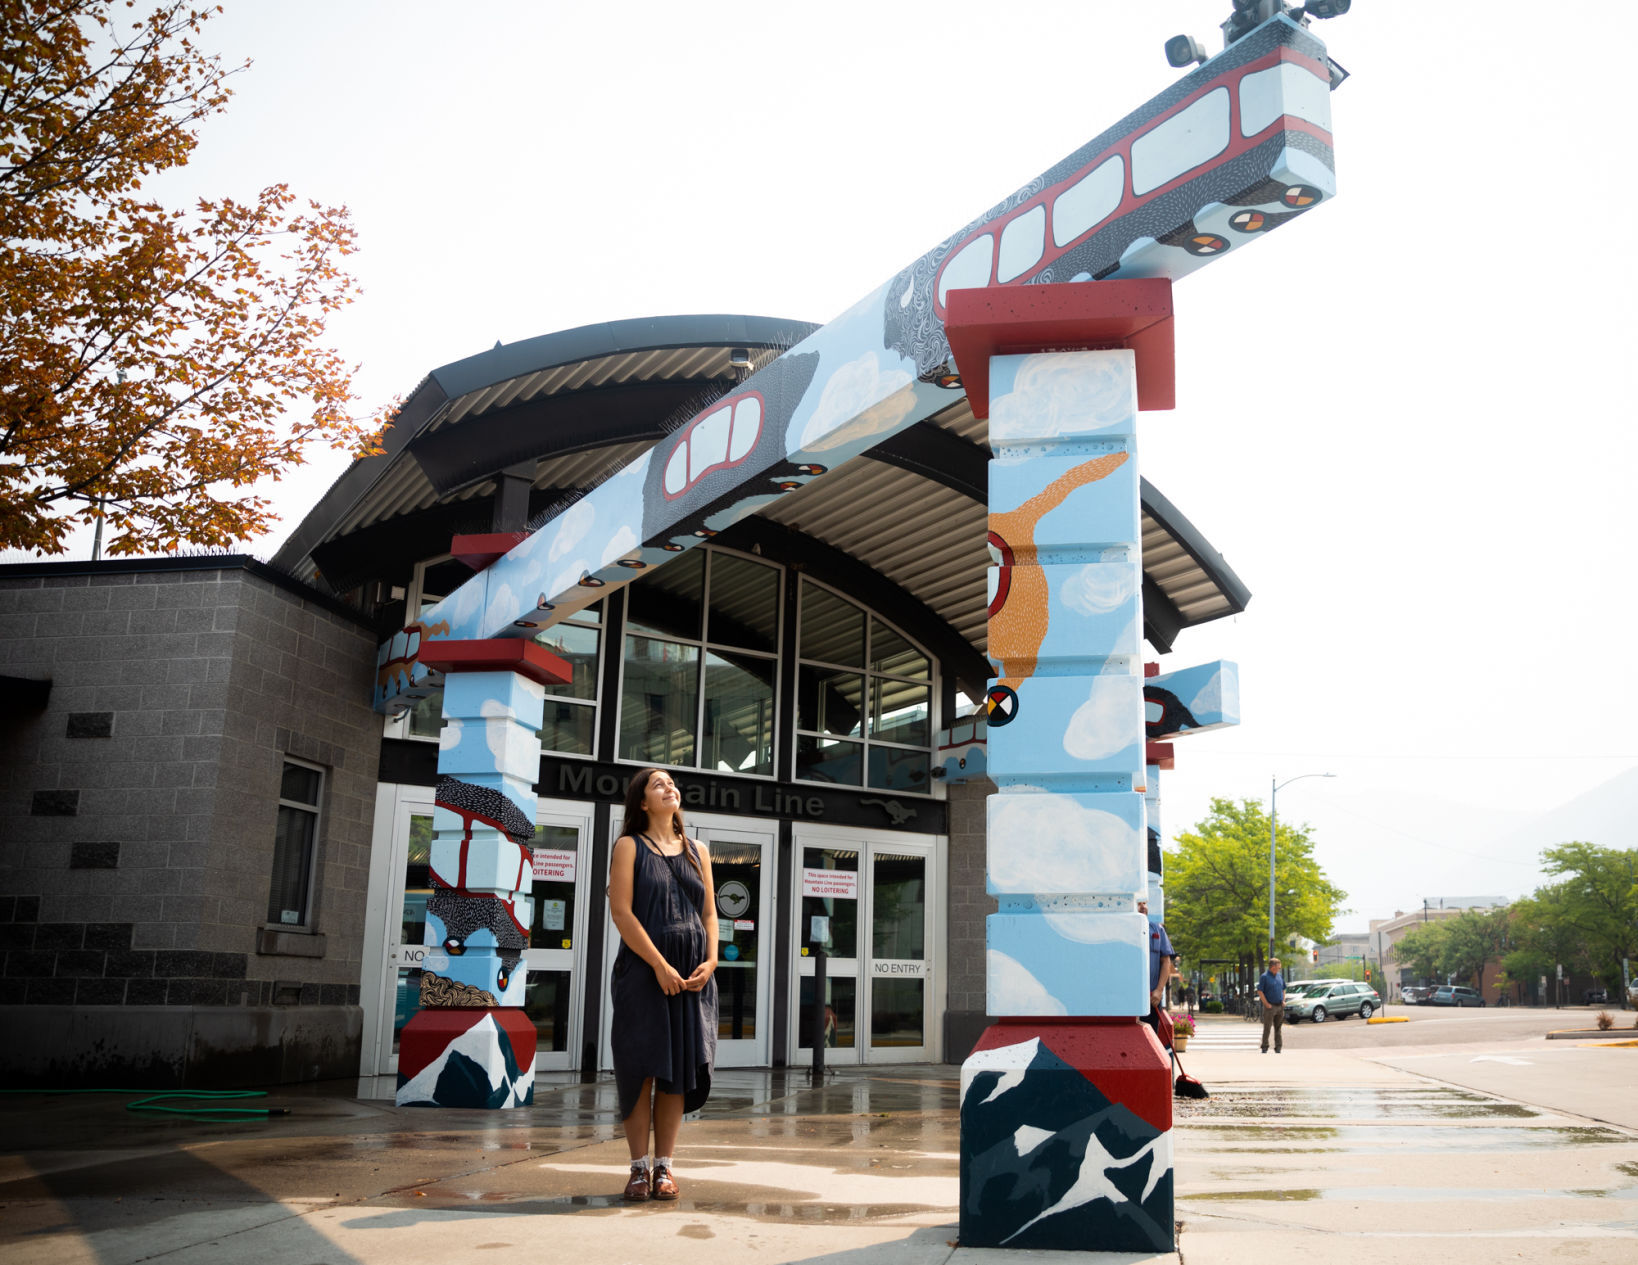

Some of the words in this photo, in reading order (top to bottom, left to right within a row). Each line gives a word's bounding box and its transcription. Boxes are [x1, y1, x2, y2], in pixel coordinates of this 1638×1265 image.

[559, 764, 741, 809] Moain
[755, 784, 825, 816] Line
[533, 868, 564, 876] OITERING
[405, 950, 425, 961] NO
[875, 963, 889, 973] NO
[891, 964, 920, 974] ENTRY
